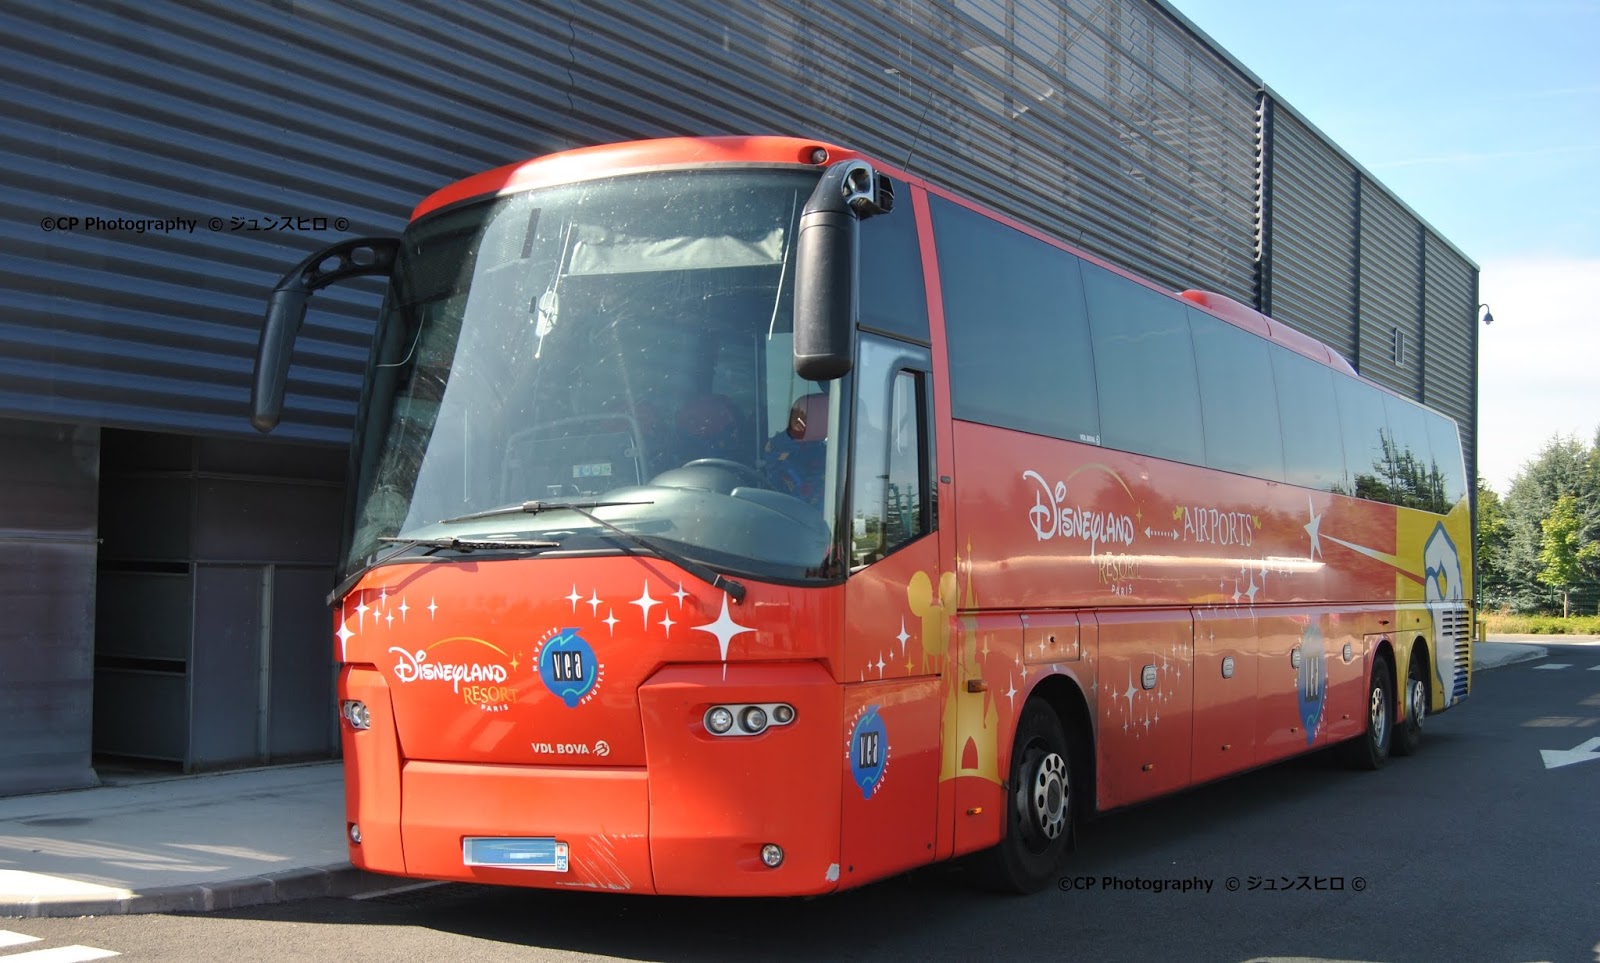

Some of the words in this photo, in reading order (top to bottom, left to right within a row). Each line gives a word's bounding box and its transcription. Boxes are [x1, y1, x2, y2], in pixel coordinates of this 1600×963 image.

[1182, 506, 1252, 547] AIRPORTS
[1111, 584, 1133, 596] PARIS
[581, 663, 605, 705] SHUTTLE
[462, 685, 519, 705] RESORT
[480, 703, 509, 712] PARIS
[531, 743, 555, 754] VDL
[556, 743, 590, 754] BOVA
[557, 859, 566, 869] 95
